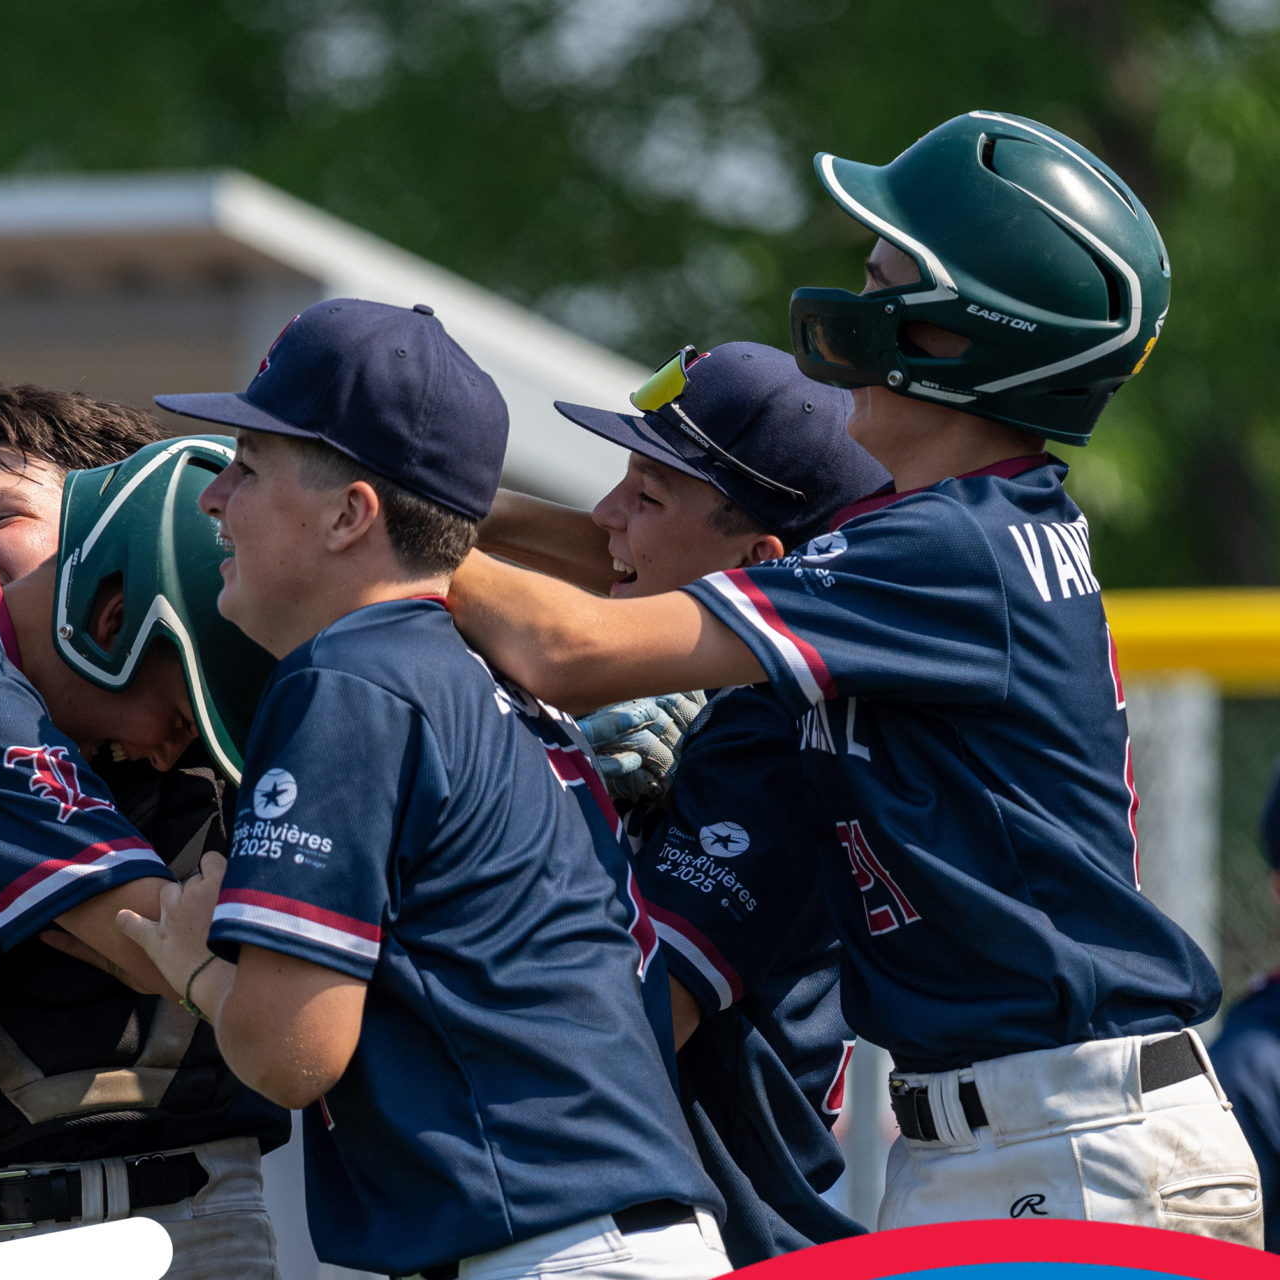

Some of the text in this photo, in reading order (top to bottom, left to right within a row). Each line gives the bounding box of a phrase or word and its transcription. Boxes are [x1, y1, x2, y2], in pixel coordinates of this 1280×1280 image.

[966, 303, 1038, 333] EASTON
[239, 838, 284, 860] 2025
[670, 865, 717, 893] 2025
